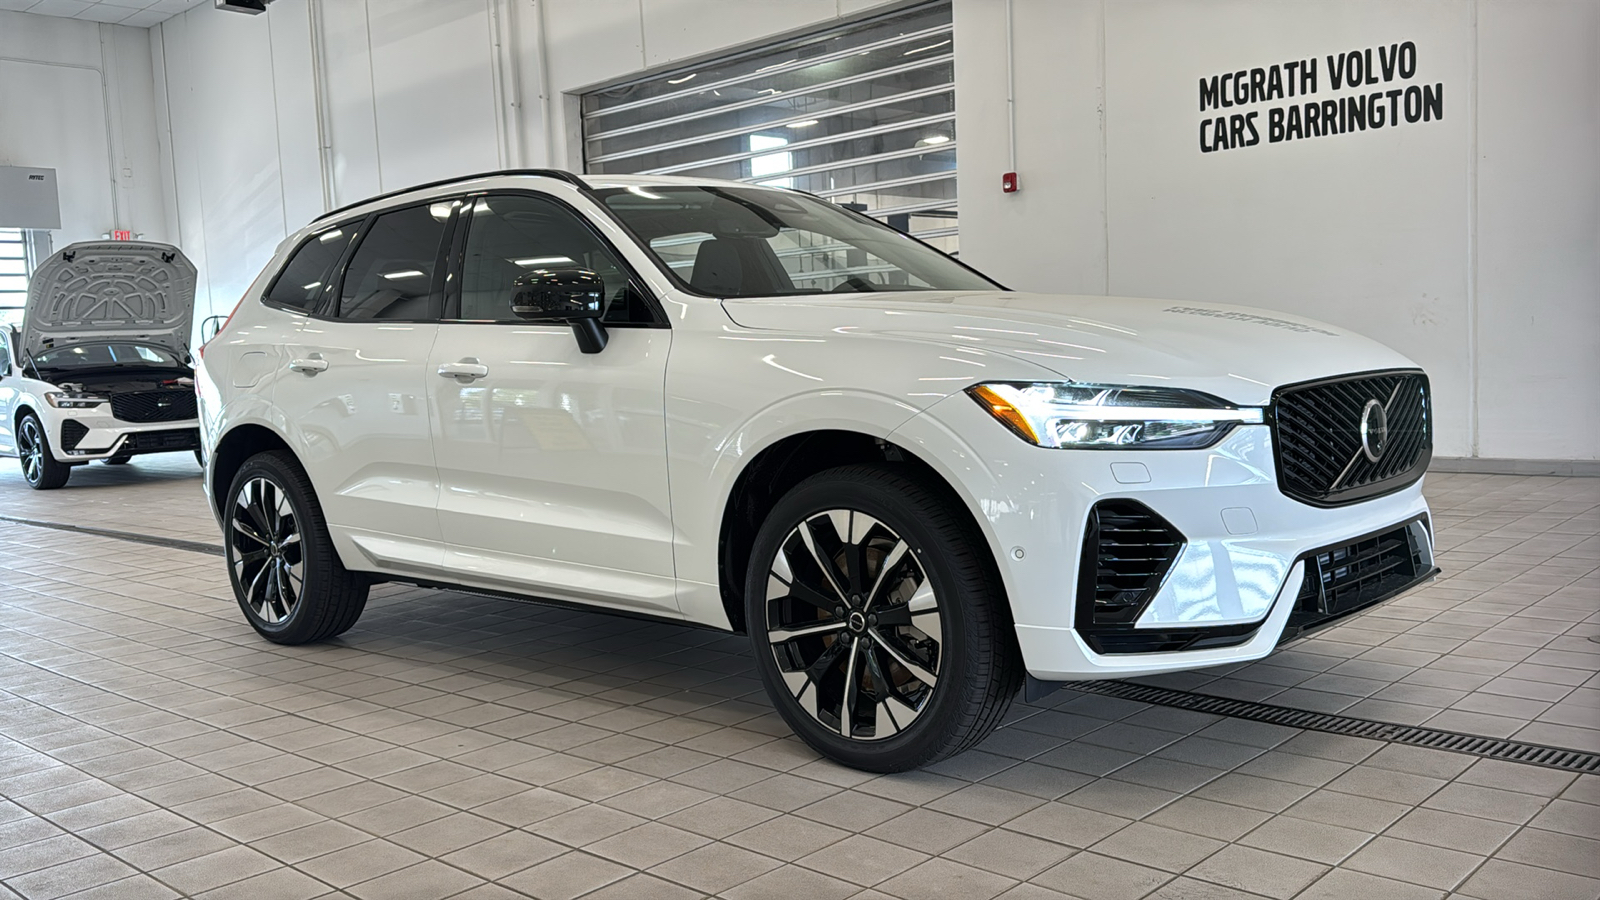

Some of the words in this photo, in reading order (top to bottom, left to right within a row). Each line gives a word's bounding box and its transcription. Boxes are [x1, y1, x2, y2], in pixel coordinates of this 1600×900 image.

[1199, 58, 1318, 112] MCGRATH
[1326, 41, 1417, 91] VOLVO
[1199, 111, 1260, 153] CARS
[1268, 82, 1443, 144] BARRINGTON
[114, 230, 130, 241] EXIT
